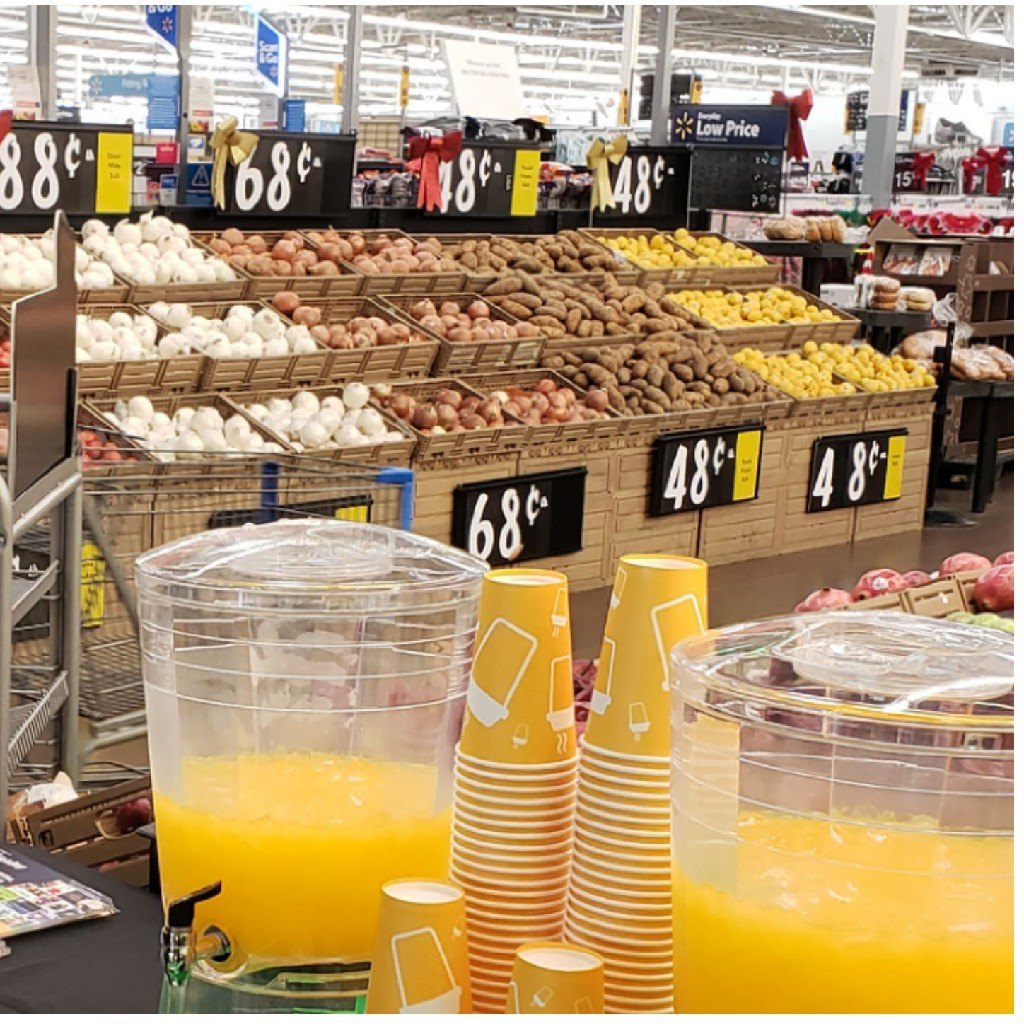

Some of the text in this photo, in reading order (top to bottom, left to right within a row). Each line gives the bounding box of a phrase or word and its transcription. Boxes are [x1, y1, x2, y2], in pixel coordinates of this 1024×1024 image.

[696, 119, 761, 138] Low Price
[235, 141, 312, 212] 68¢
[612, 154, 666, 215] 48¢
[663, 436, 726, 510] 48¢
[468, 483, 540, 561] 68¢
